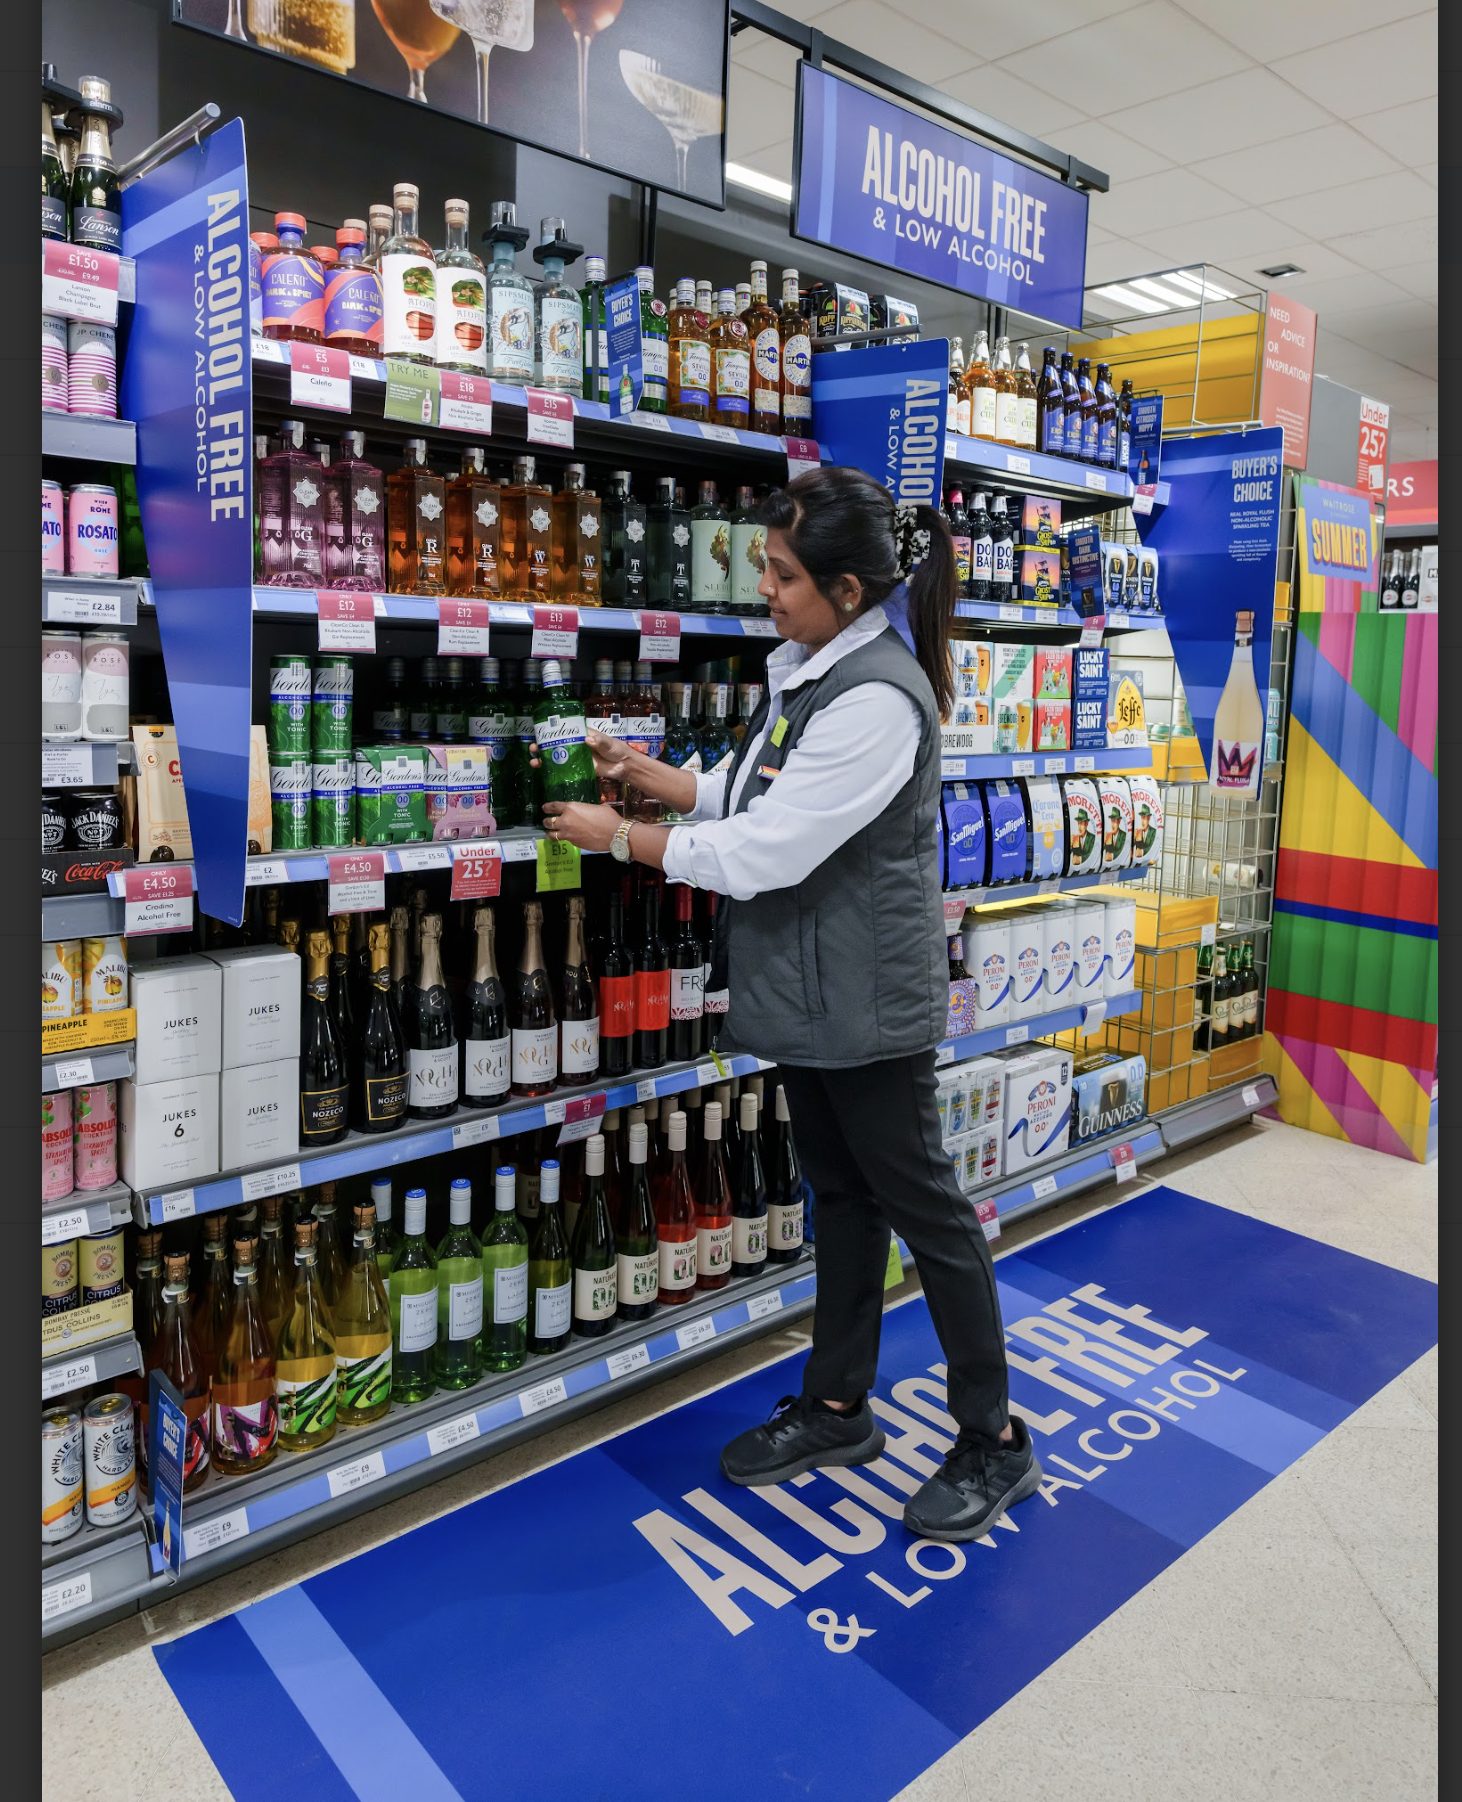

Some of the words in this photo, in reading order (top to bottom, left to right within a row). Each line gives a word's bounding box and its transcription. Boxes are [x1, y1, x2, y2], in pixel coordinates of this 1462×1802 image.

[89, 99, 113, 112] alarm
[862, 125, 985, 240] ALCOHOL
[991, 180, 1047, 264] FREE
[79, 215, 119, 236] Lanson
[873, 207, 886, 231] &
[895, 214, 942, 250] LOW
[948, 235, 1034, 286] ALCOHOL
[194, 245, 204, 264] &
[68, 254, 99, 271] £1.50
[82, 272, 100, 283] £9.49
[208, 189, 244, 405] ALCOHOL
[611, 294, 633, 312] BUYER'S
[194, 271, 206, 339] LOW
[1270, 307, 1290, 324] NEED
[1281, 328, 1306, 348] ADVICE
[1267, 341, 1279, 354] OR
[315, 353, 328, 363] £5
[389, 362, 411, 376] TRY
[413, 367, 430, 380] ME
[1266, 357, 1311, 385] INSPIRATION?
[310, 377, 333, 387] Caleño
[459, 381, 475, 393] £18
[543, 398, 558, 410] £15
[889, 408, 900, 420] &
[1361, 402, 1388, 424] Under
[195, 351, 208, 492] ALCOHOL
[886, 425, 899, 470] LOW
[1360, 426, 1386, 460] 25?
[209, 410, 245, 522] FREE
[1231, 456, 1278, 480] BUYER'S
[1233, 480, 1274, 503] CHOICE
[90, 506, 111, 514] ROME
[1322, 498, 1356, 514] WAITROSE
[300, 530, 313, 542] G
[361, 536, 374, 548] G
[427, 541, 438, 554] R
[1312, 517, 1368, 570] SUMMER
[482, 547, 493, 559] R
[534, 553, 546, 564] W
[584, 558, 596, 568] W
[631, 561, 641, 573] T
[92, 603, 116, 612] £2.84
[339, 600, 356, 611] £12
[457, 607, 472, 618] £12
[550, 612, 563, 622] £13
[1079, 651, 1104, 666] LUCKY
[1079, 664, 1103, 678] SAINT
[1076, 702, 1102, 715] LUCKY
[1118, 697, 1142, 726] Leffe
[1077, 715, 1102, 729] SAINT
[61, 776, 83, 784] £3.65
[71, 814, 89, 829] JACK
[89, 810, 120, 829] DANIEL'S
[460, 846, 496, 858] Under
[263, 866, 273, 875] £2
[344, 861, 372, 874] £4.50
[462, 860, 494, 879] 25?
[143, 877, 177, 891] £4.50
[145, 903, 174, 912] Crodino
[137, 913, 165, 922] Alcohol
[166, 911, 182, 919] Free
[1115, 938, 1133, 949] PERONI
[1051, 952, 1071, 963] PERONI
[1082, 946, 1101, 956] PERONI
[1018, 958, 1039, 970] PERONI
[983, 966, 1005, 977] PERONI
[248, 1003, 280, 1017] JUKES
[42, 1019, 88, 1033] PINEAPPLE
[164, 1017, 198, 1029] JUKES
[1130, 1063, 1144, 1083] 0.0
[378, 1093, 406, 1105] NOZECO
[1027, 1095, 1056, 1115] PERONI
[162, 1109, 197, 1123] JUKES
[247, 1103, 279, 1116] JUKES
[312, 1106, 344, 1119] NOZECO
[1078, 1100, 1143, 1138] GUINNESS
[174, 1123, 185, 1138] 6
[58, 1217, 82, 1229] £2.50
[86, 1285, 122, 1300] CITRUS
[1004, 1282, 1210, 1408] FREE
[67, 1365, 90, 1378] £2.50
[458, 1421, 475, 1433] £4.50
[51, 1441, 71, 1475] WHITE
[361, 1464, 370, 1474] £9
[806, 1608, 878, 1654] &
[1037, 1359, 1248, 1508] ALCOHOL
[222, 1521, 232, 1533] £9
[62, 1584, 87, 1599] £2.20
